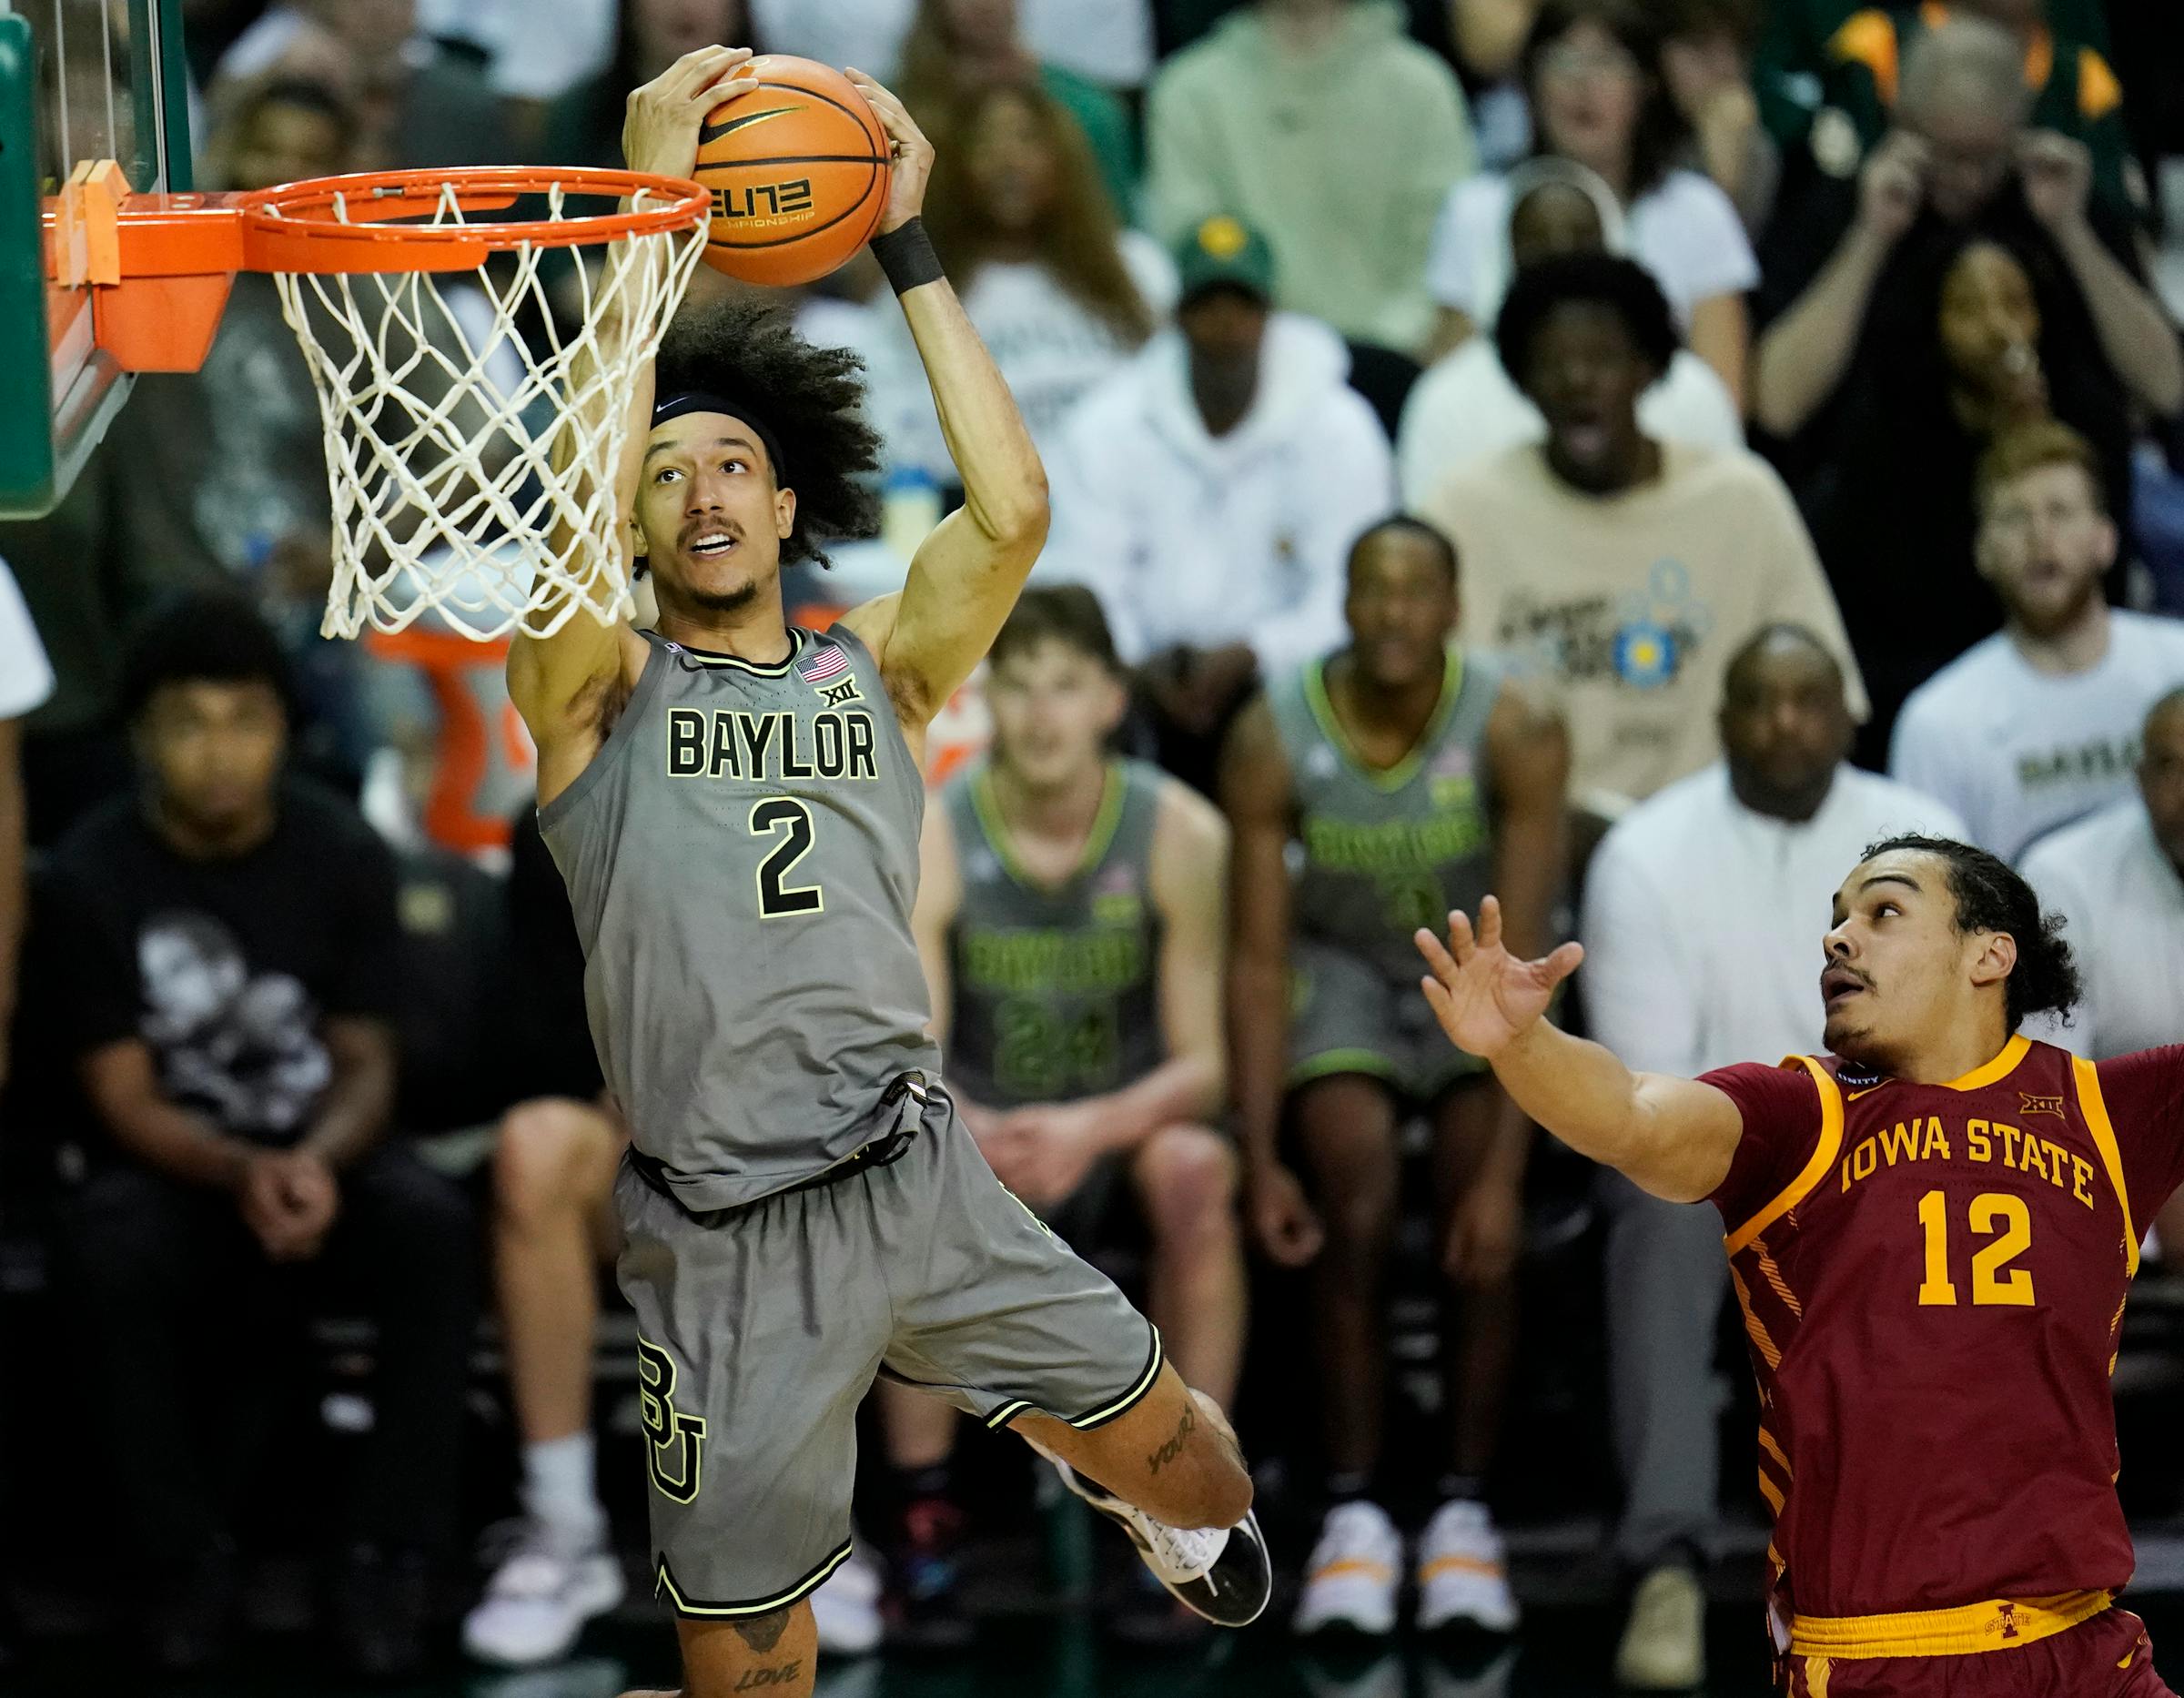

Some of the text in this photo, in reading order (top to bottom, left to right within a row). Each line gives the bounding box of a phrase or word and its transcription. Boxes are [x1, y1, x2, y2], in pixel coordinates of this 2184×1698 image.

[710, 178, 813, 217] ELITE
[667, 708, 879, 782] BAYLOR
[749, 796, 824, 919] 2
[1837, 1072, 1879, 1086] UNITY
[1842, 1117, 2094, 1210] IOWA STATE
[1918, 1190, 2036, 1306] 12
[734, 1659, 803, 1693] LOVE
